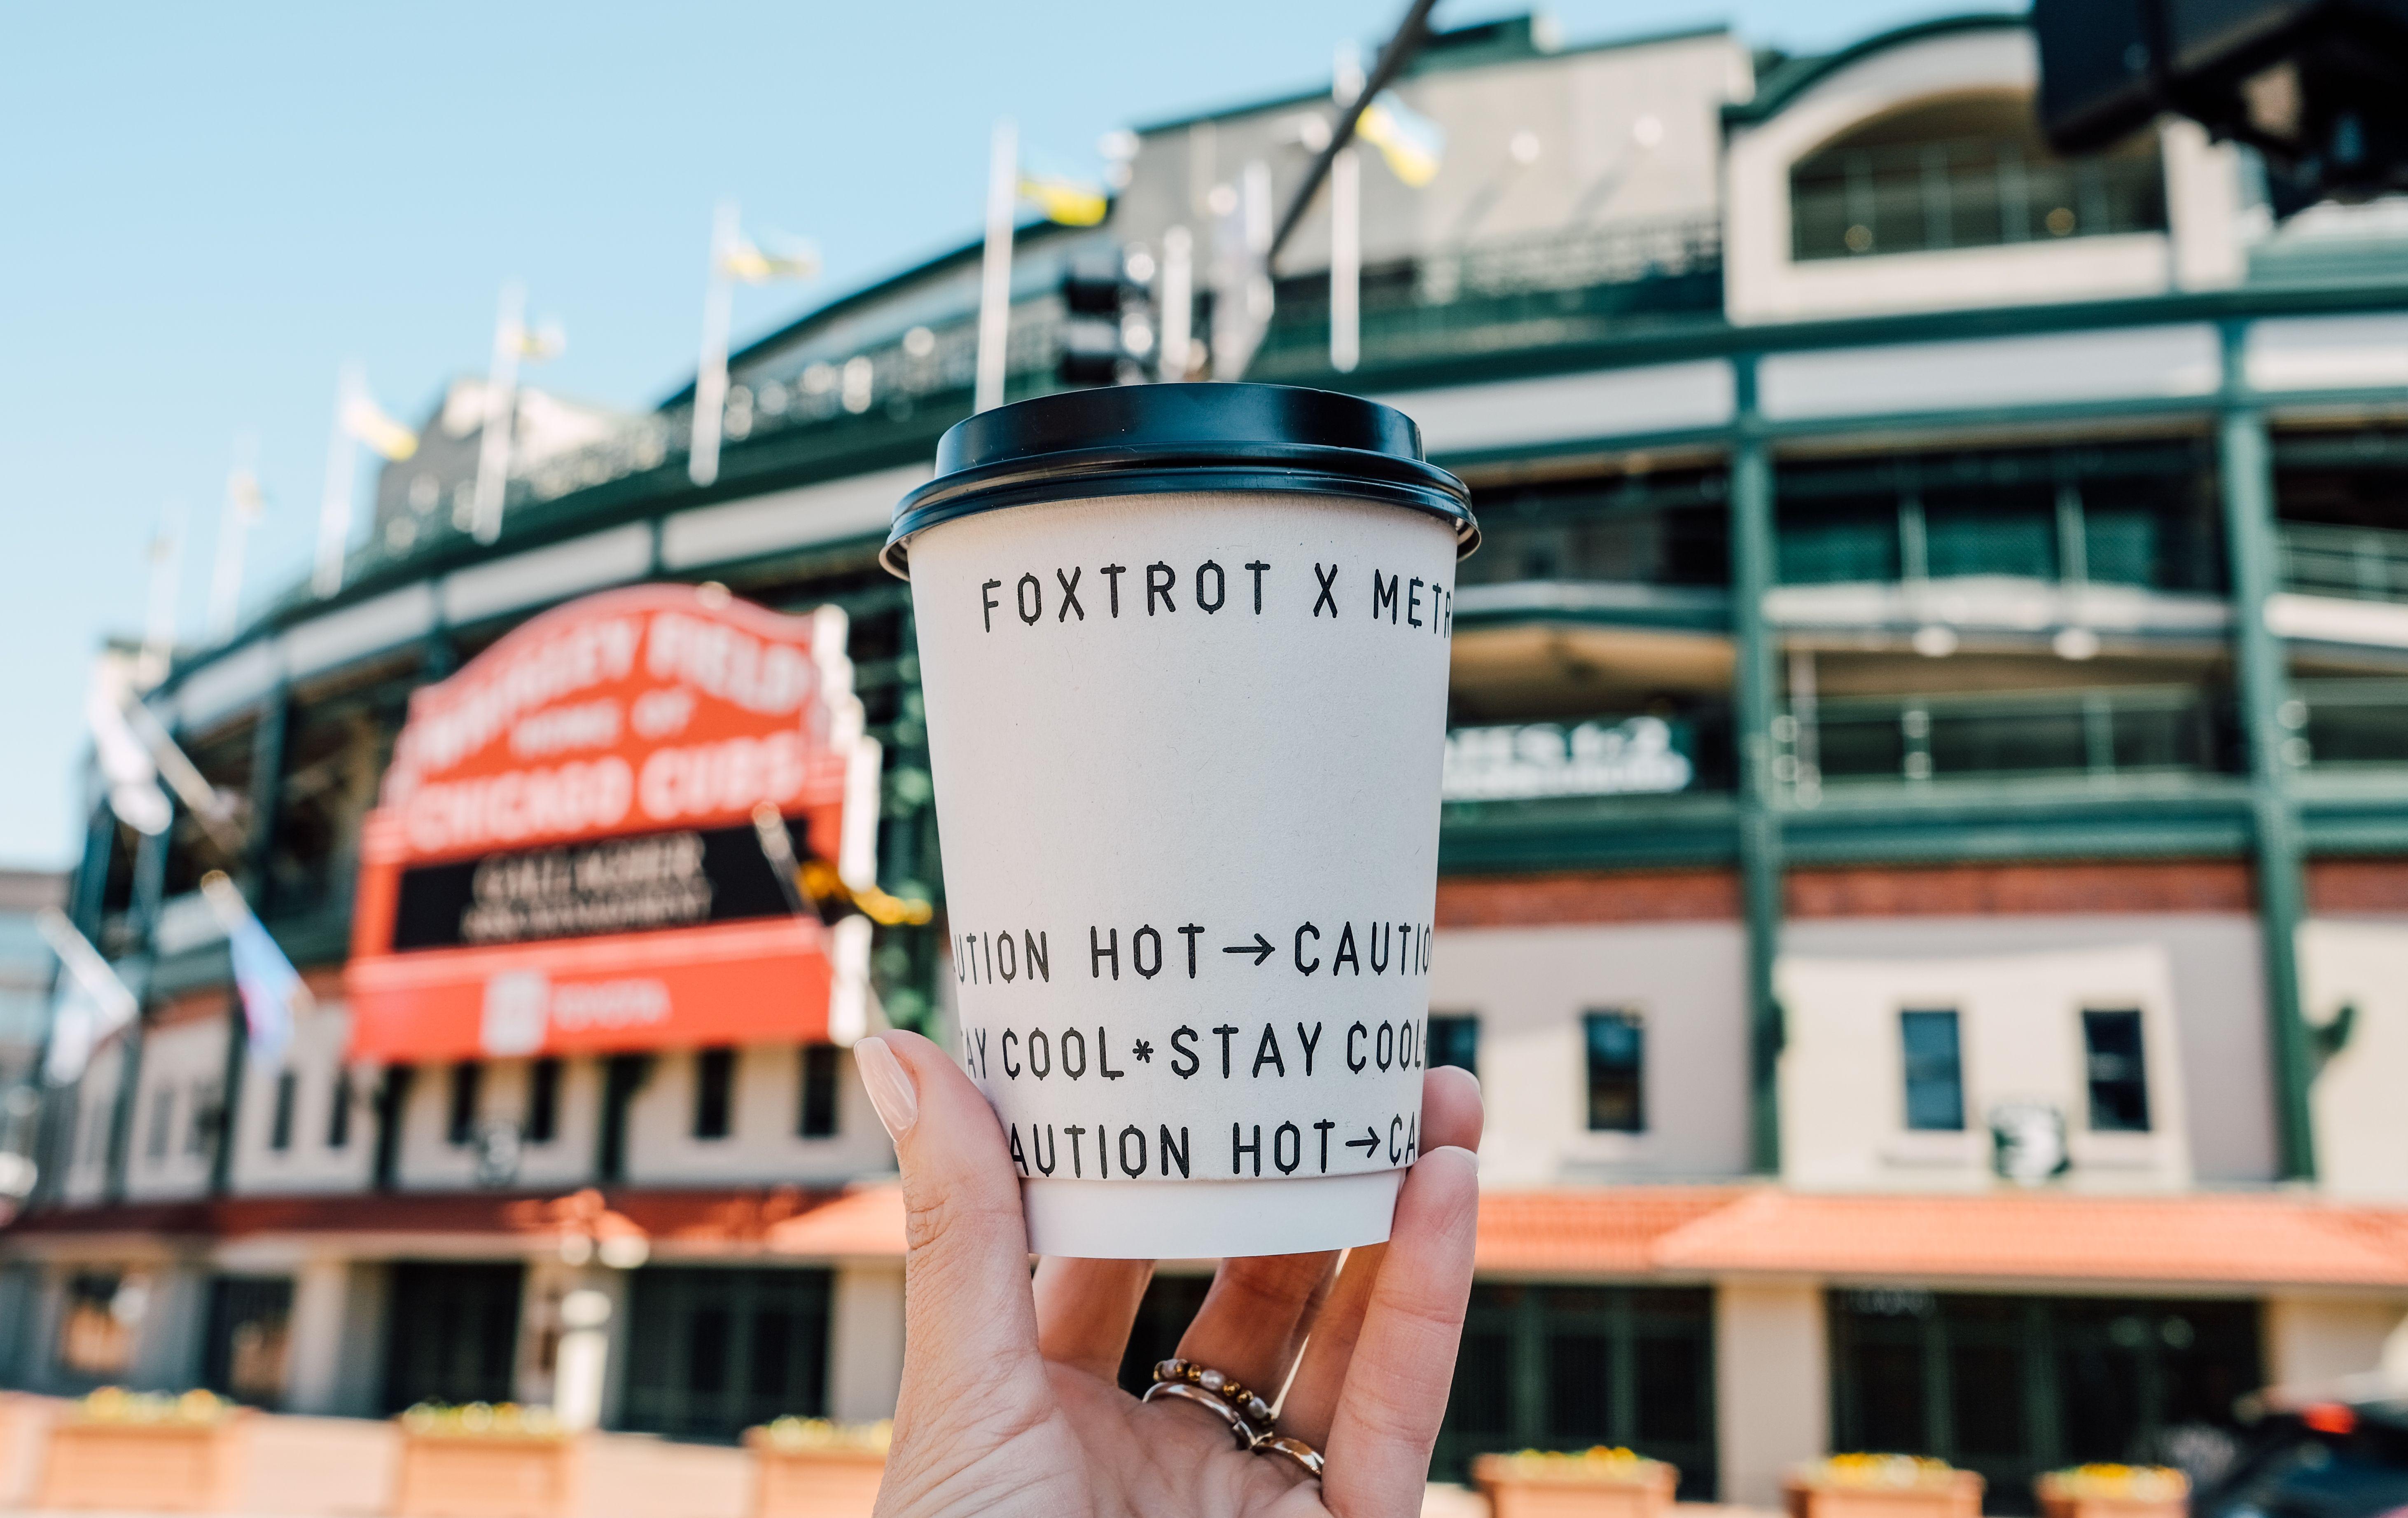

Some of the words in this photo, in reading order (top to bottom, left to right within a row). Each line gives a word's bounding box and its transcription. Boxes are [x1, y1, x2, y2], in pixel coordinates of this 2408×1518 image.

[982, 559, 1271, 633] FOXTROT
[1313, 562, 1338, 619] X
[1373, 568, 1451, 639] METR
[954, 929, 1049, 985] UTION
[1090, 922, 1205, 981] HOT
[1294, 921, 1432, 977] CAUTIO
[960, 1028, 986, 1080] AY
[1010, 1123, 1190, 1179] AUTION
[1232, 1118, 1335, 1177] HOT
[1389, 1109, 1421, 1167] CA
